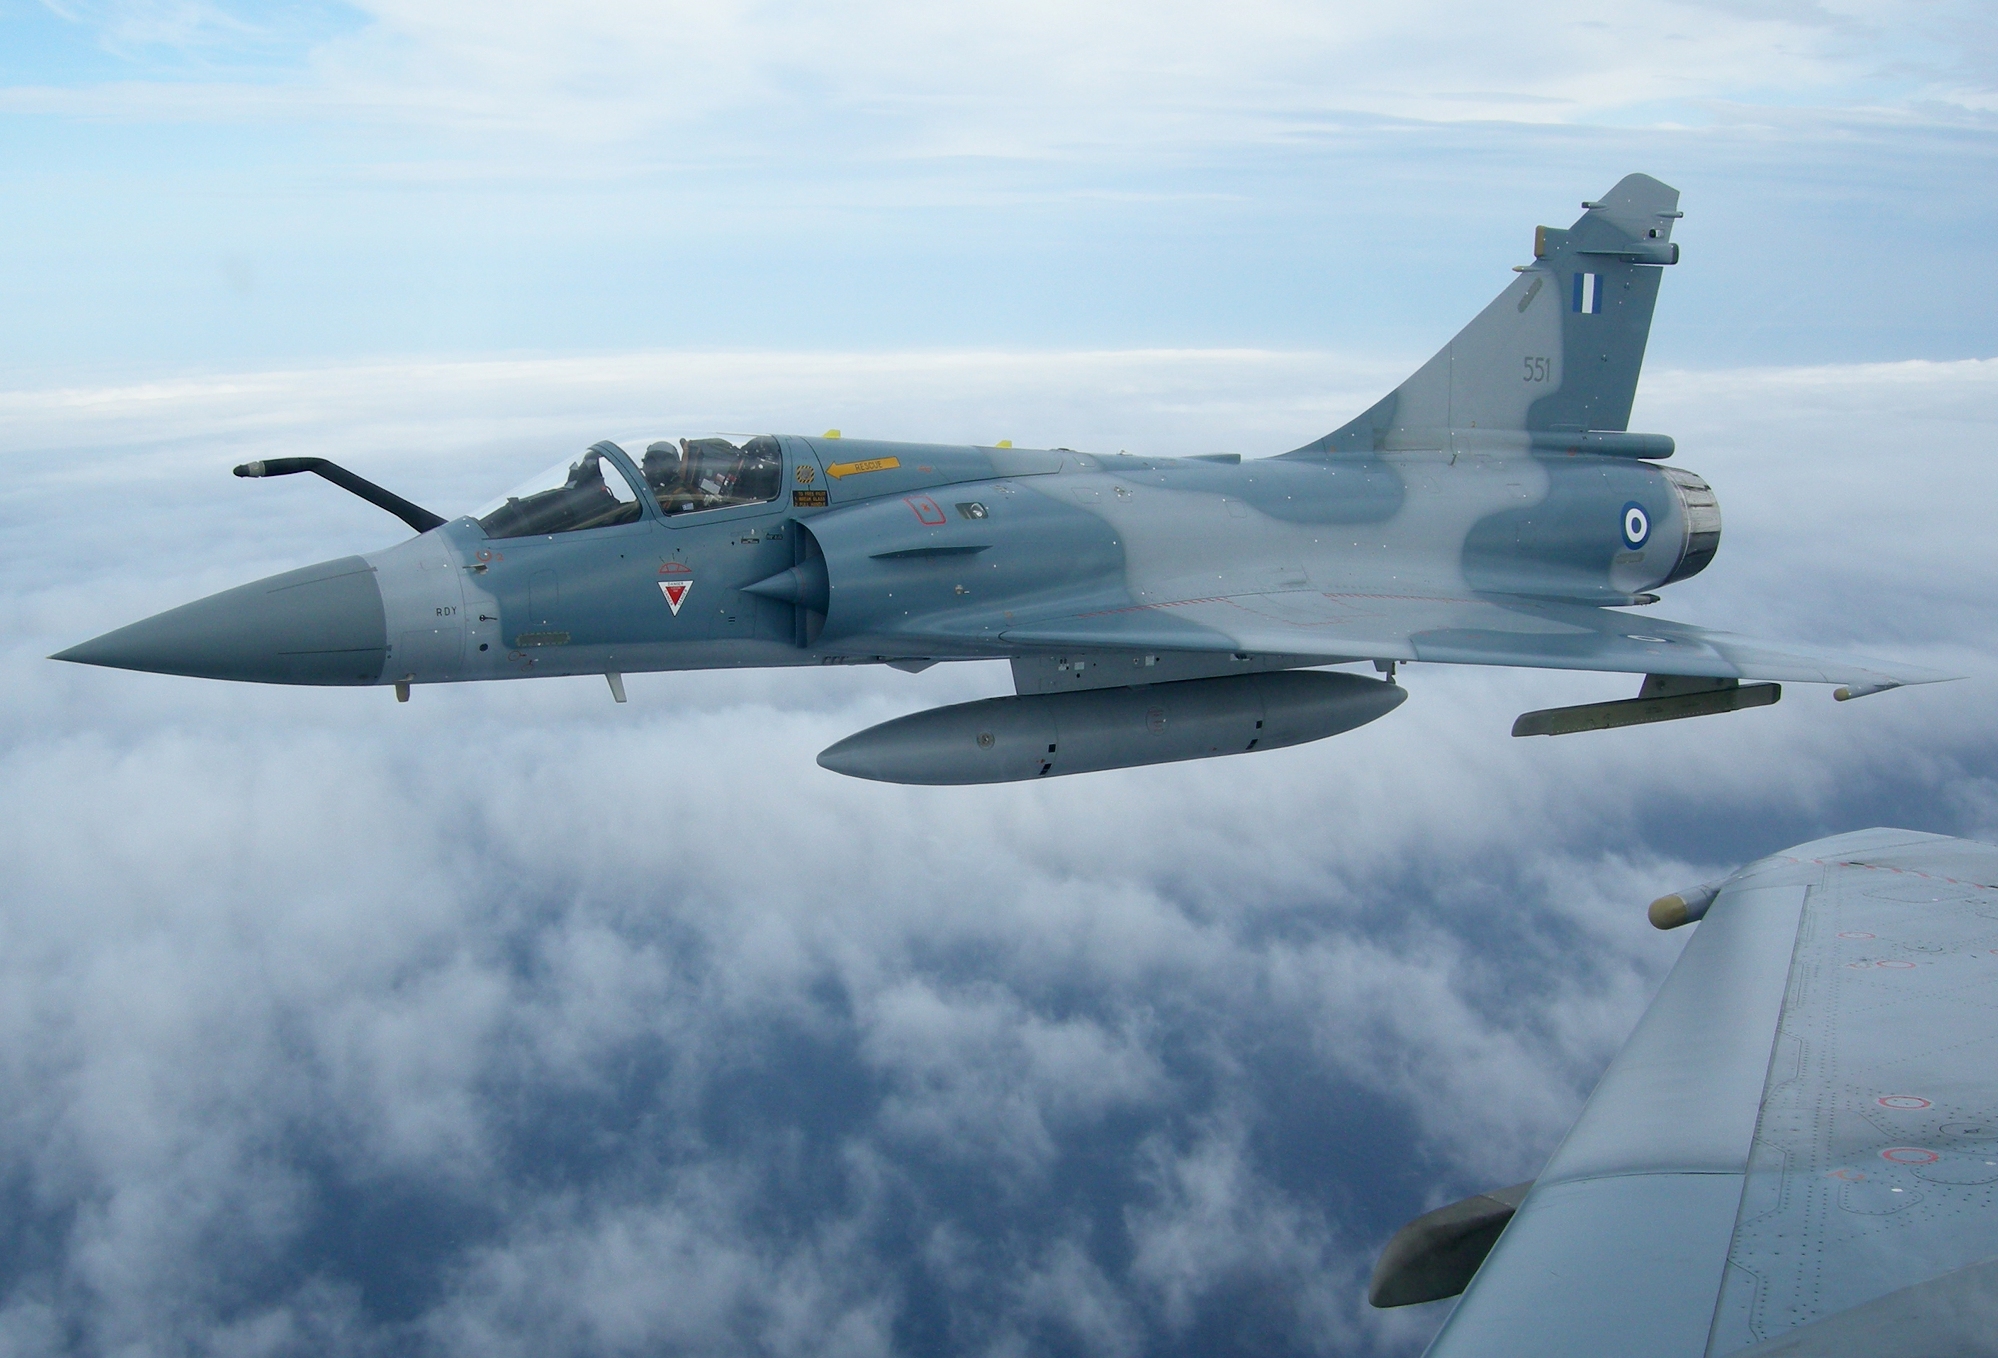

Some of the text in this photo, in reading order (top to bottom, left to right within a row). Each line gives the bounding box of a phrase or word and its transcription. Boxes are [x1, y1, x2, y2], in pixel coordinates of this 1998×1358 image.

[1523, 356, 1550, 382] 551
[855, 461, 882, 471] RESCUE
[436, 606, 457, 616] RDY
